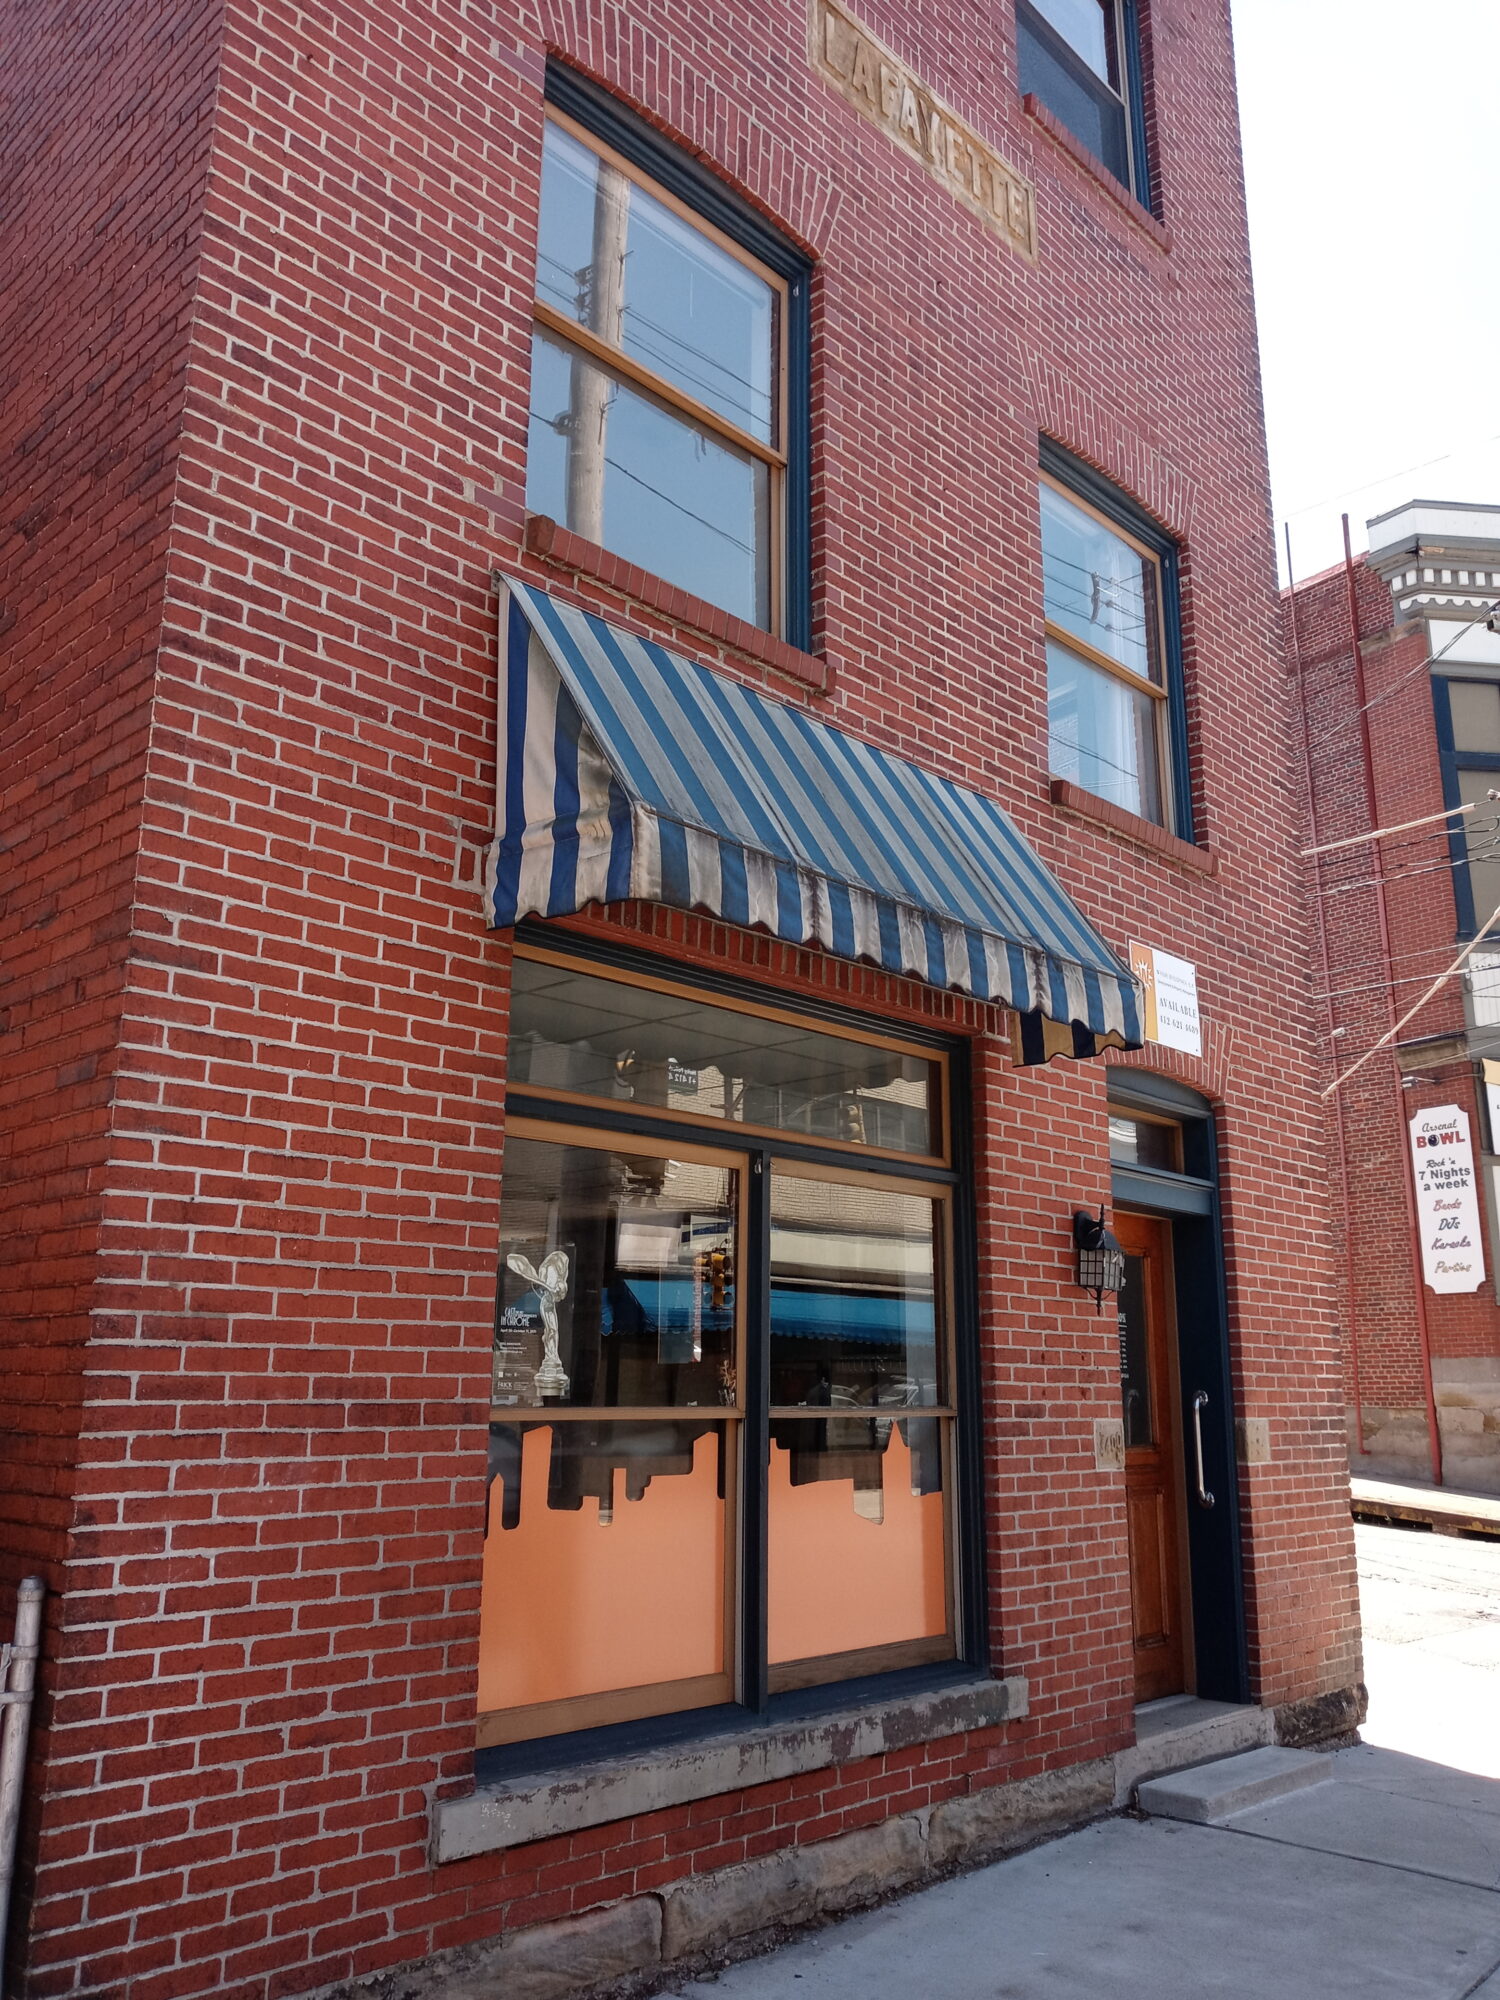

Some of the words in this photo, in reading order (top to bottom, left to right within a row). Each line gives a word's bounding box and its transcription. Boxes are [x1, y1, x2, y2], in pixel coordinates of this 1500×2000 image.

[823, 10, 1026, 240] LAFAYETTE
[1159, 997, 1197, 1019] AVAILABLE
[1422, 1119, 1457, 1132] Arsenal
[1426, 1157, 1445, 1168] Rock
[1419, 1170, 1426, 1180] 7
[1430, 1166, 1471, 1183] Nights
[1424, 1182, 1431, 1191] a
[1434, 1177, 1469, 1191] week
[1433, 1198, 1462, 1211] Bands
[1438, 1216, 1460, 1230] DJs
[1431, 1235, 1471, 1250] Karaoke
[1434, 1261, 1472, 1273] Parties
